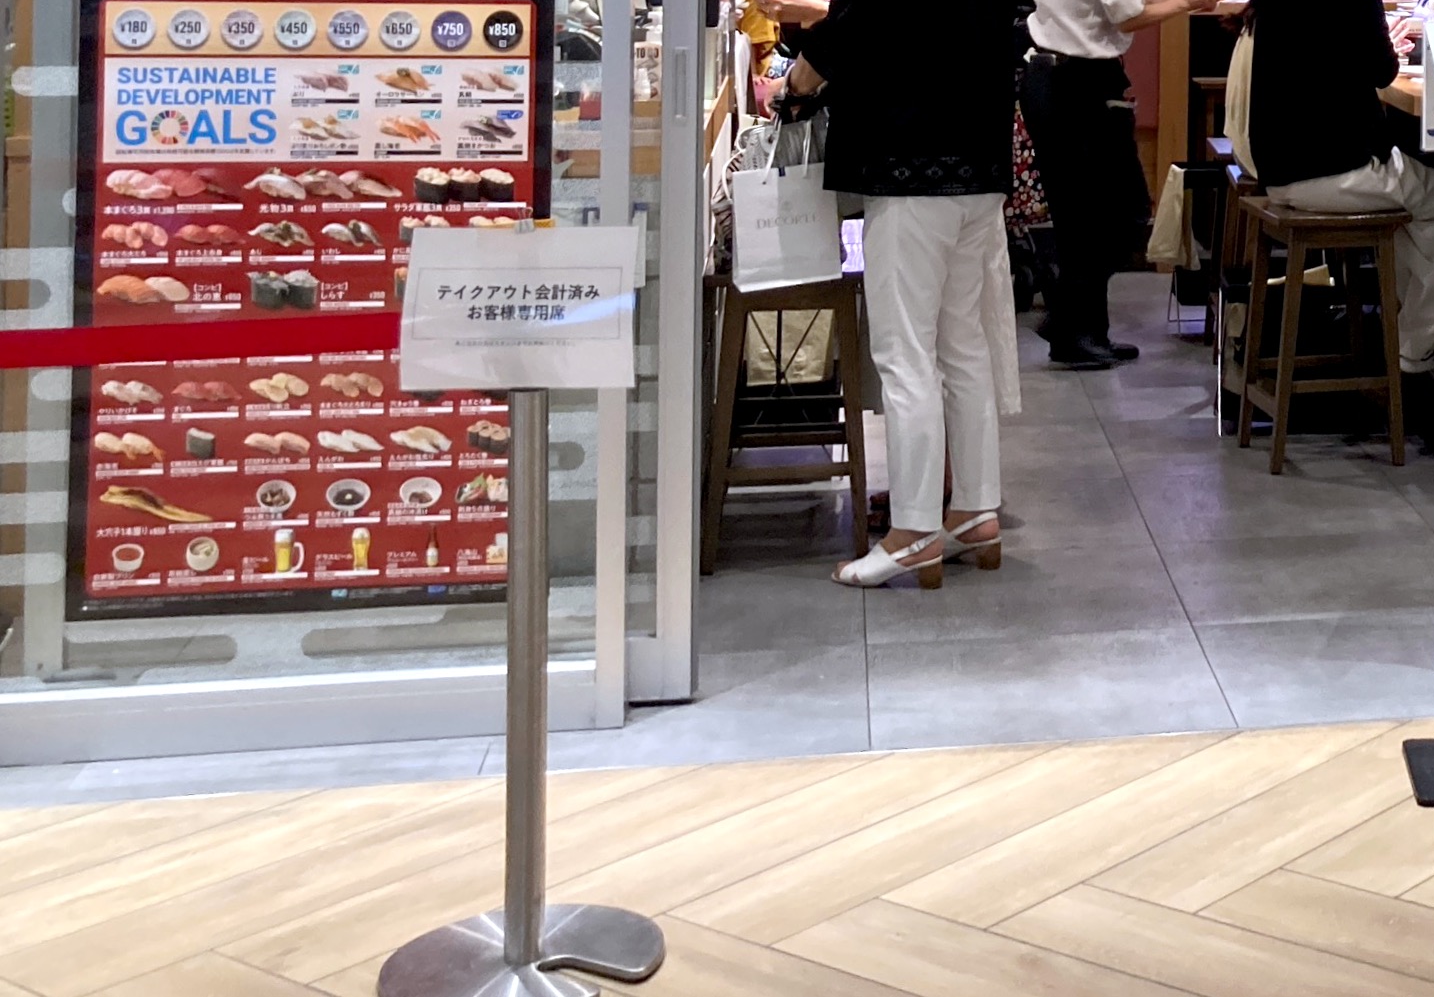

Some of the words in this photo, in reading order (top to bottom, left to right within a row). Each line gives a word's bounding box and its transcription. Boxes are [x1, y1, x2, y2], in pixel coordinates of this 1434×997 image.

[121, 21, 147, 34] ¥180
[174, 21, 201, 34] ¥250
[228, 21, 255, 34] ¥350
[281, 21, 308, 34] ¥450
[385, 22, 413, 35] ¥650
[437, 22, 464, 36] ¥750
[489, 22, 516, 36] ¥850
[117, 67, 277, 84] SUSTAINABLE
[117, 89, 276, 105] DEVELOPMENT
[437, 285, 600, 301] テイクアウト会計済み
[467, 304, 565, 321] お客様専用席
